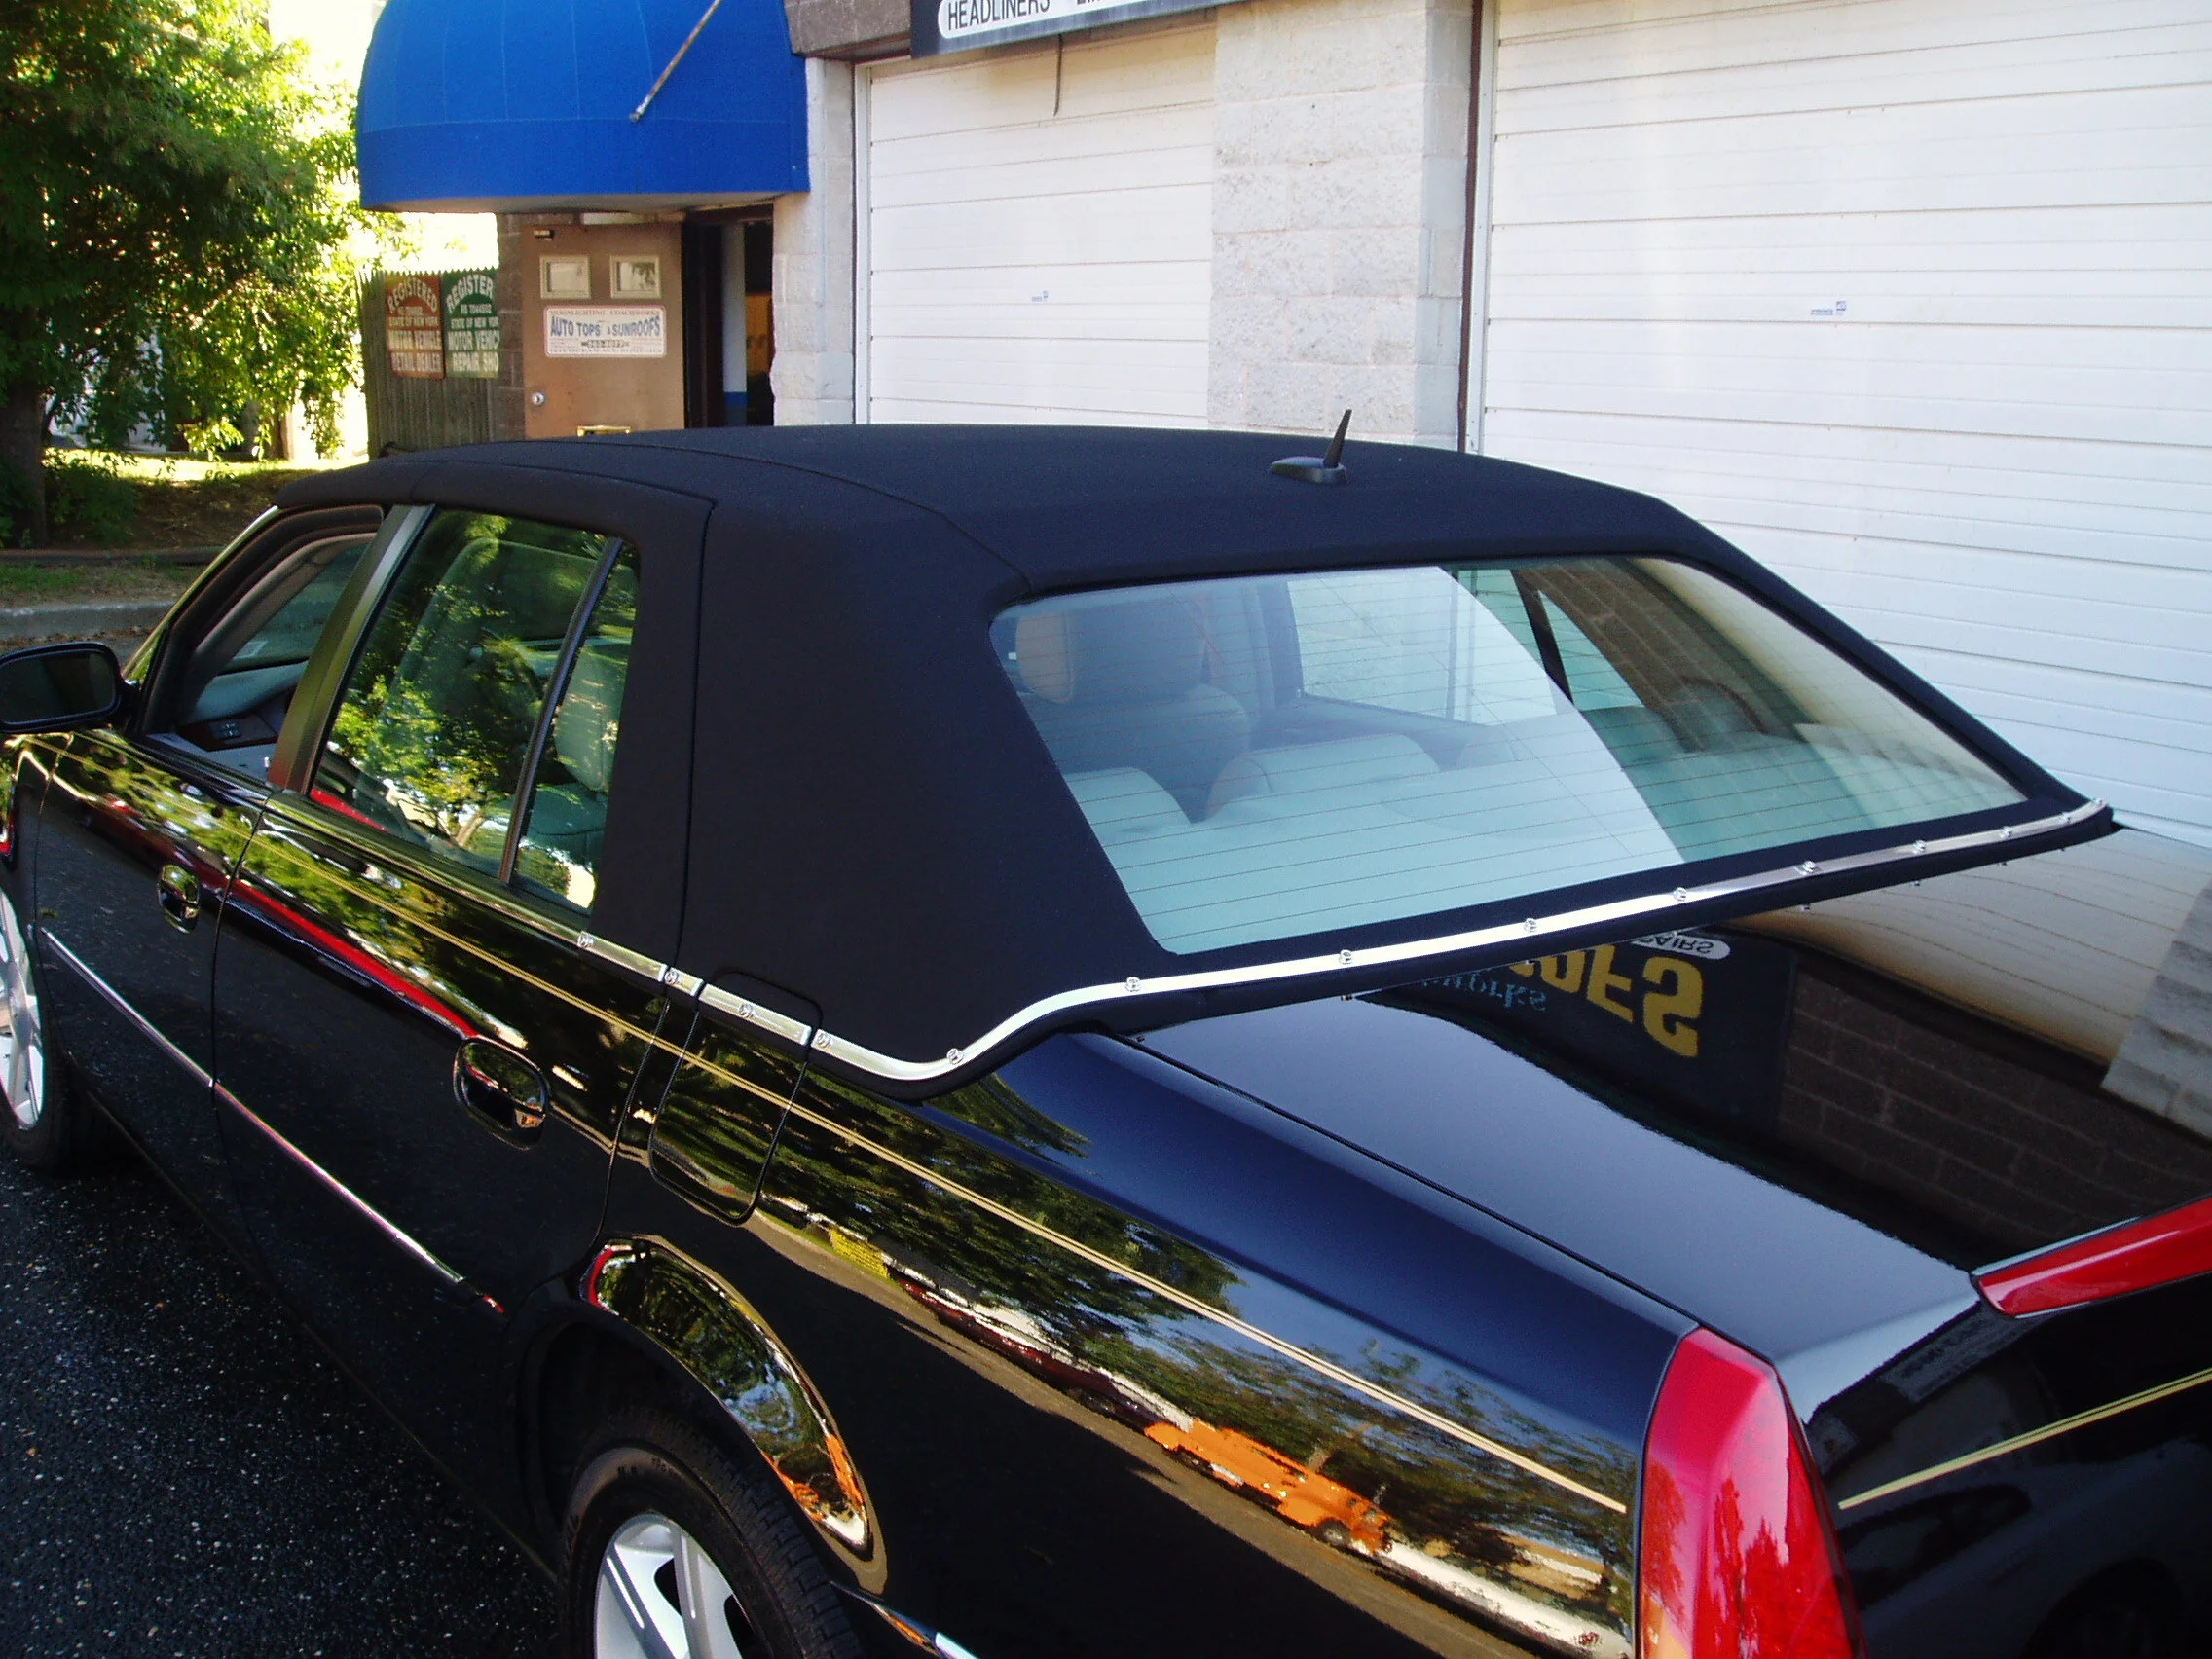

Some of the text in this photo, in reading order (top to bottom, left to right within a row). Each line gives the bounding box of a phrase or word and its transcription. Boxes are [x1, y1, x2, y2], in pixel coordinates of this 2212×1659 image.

[550, 316, 574, 337] AUTO
[576, 322, 601, 337] TOPS
[612, 315, 661, 337] SUNROOFS
[448, 331, 473, 350] MOTOR
